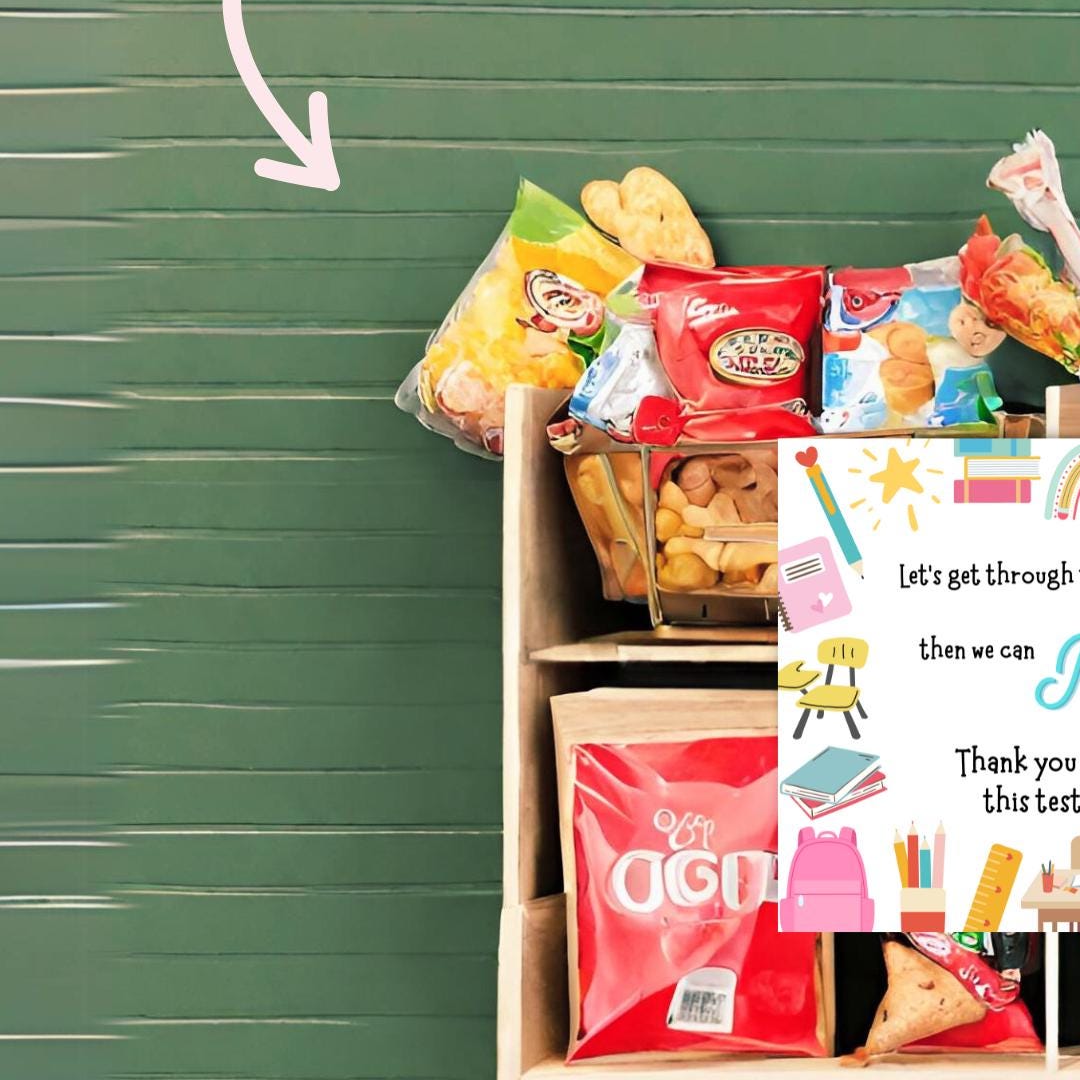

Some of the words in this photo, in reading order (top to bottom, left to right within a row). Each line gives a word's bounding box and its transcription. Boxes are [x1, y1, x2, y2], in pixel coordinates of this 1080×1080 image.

[898, 562, 943, 590] Let's
[947, 563, 982, 592] get
[985, 560, 1074, 592] through
[918, 634, 967, 661] then
[971, 643, 996, 661] we
[1000, 643, 1036, 661] can
[954, 744, 1029, 778] Thank
[1034, 756, 1077, 783] you
[982, 786, 1030, 815] this
